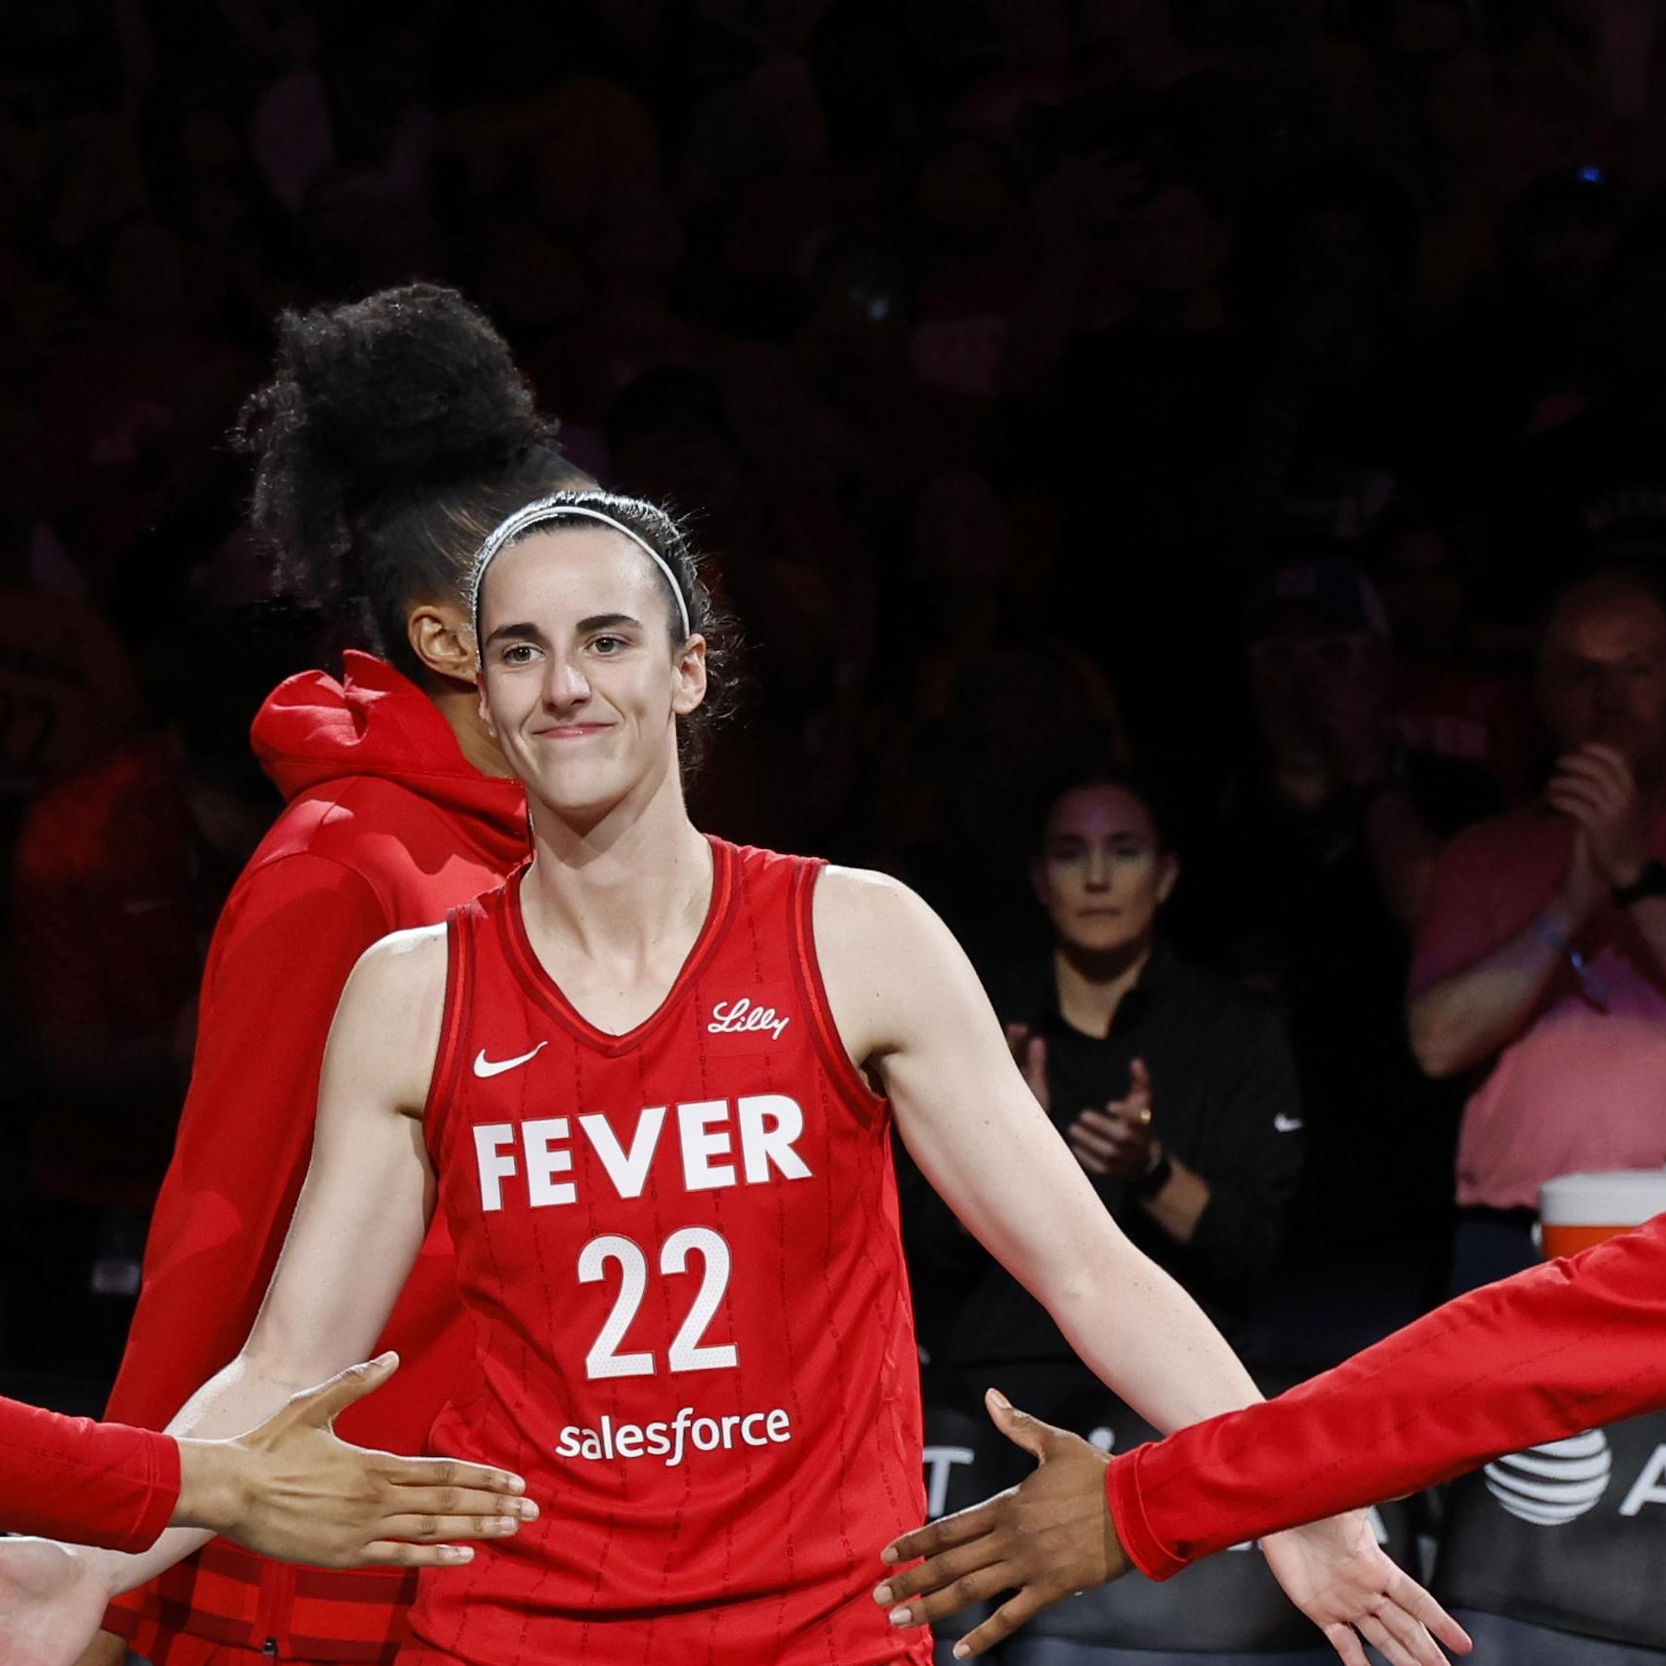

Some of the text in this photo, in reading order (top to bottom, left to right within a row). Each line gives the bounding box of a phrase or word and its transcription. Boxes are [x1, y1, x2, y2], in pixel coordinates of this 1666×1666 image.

[706, 996, 790, 1040] Lilly
[471, 1093, 814, 1212] FEVER
[575, 1224, 742, 1382] 22
[555, 1406, 791, 1467] salesforce
